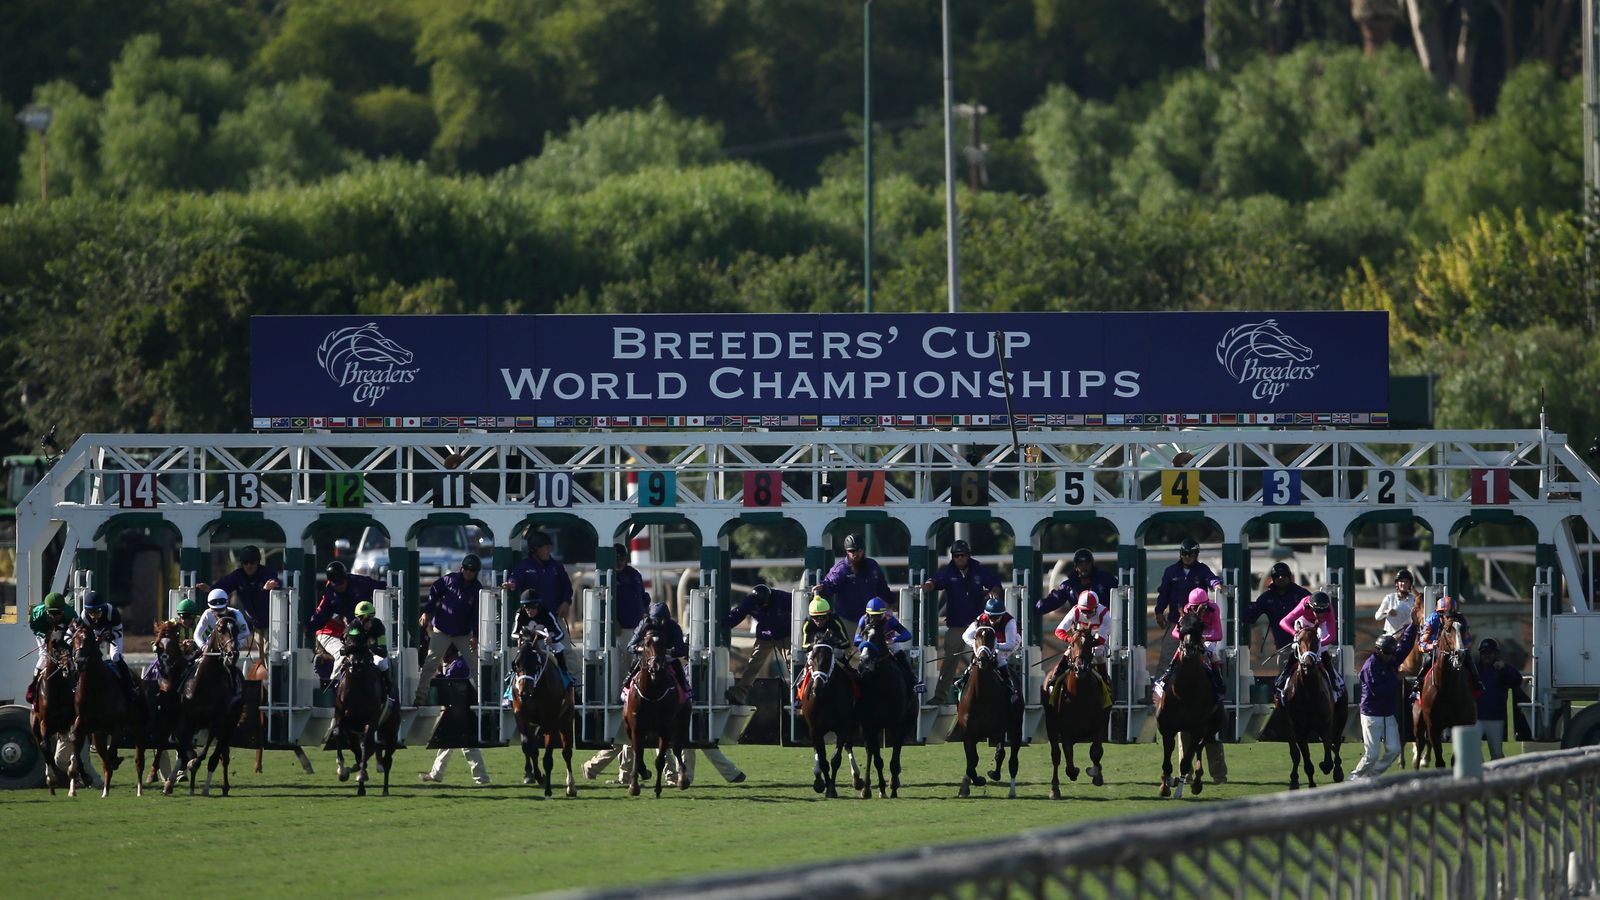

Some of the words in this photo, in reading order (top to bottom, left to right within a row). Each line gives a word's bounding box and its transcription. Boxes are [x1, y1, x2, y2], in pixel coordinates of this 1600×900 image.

[612, 326, 899, 361] BREEDERS'
[921, 326, 1032, 360] CUP
[339, 361, 420, 387] Breeders'
[500, 367, 688, 400] WORLD
[708, 366, 1141, 400] CHAMPIONSHIPS
[1239, 358, 1320, 384] Breeders'
[123, 473, 153, 508] 14
[227, 473, 258, 508] 13
[329, 472, 360, 508] 12
[442, 474, 464, 506] 11
[537, 472, 571, 507] 10
[648, 472, 666, 506] 9
[754, 472, 771, 506] 8
[856, 471, 875, 505] 7
[960, 471, 979, 506] 6
[1064, 471, 1085, 505] 5
[1171, 471, 1189, 504] 4
[1272, 470, 1291, 505] 3
[1378, 470, 1395, 504] 2
[1482, 470, 1494, 504] 1
